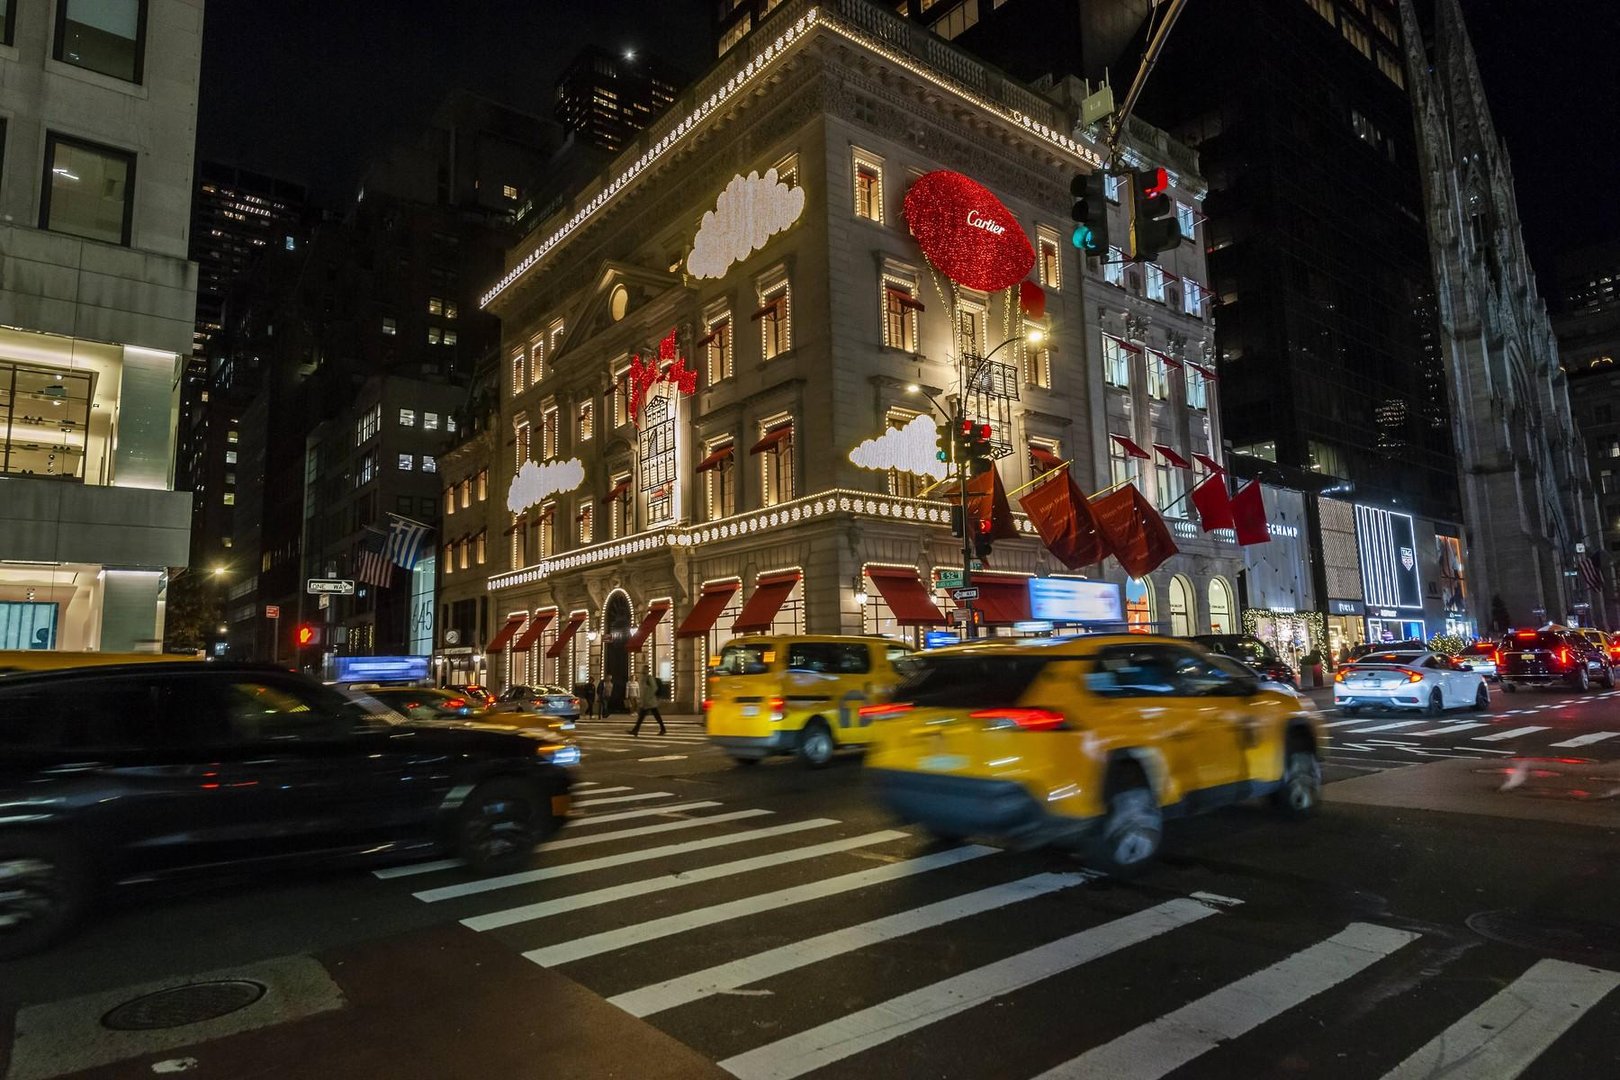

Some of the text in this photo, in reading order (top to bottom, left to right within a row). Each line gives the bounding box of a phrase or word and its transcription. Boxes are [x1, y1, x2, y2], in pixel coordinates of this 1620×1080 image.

[967, 210, 1005, 235] Cartier
[947, 571, 955, 579] 52
[412, 600, 433, 633] 645
